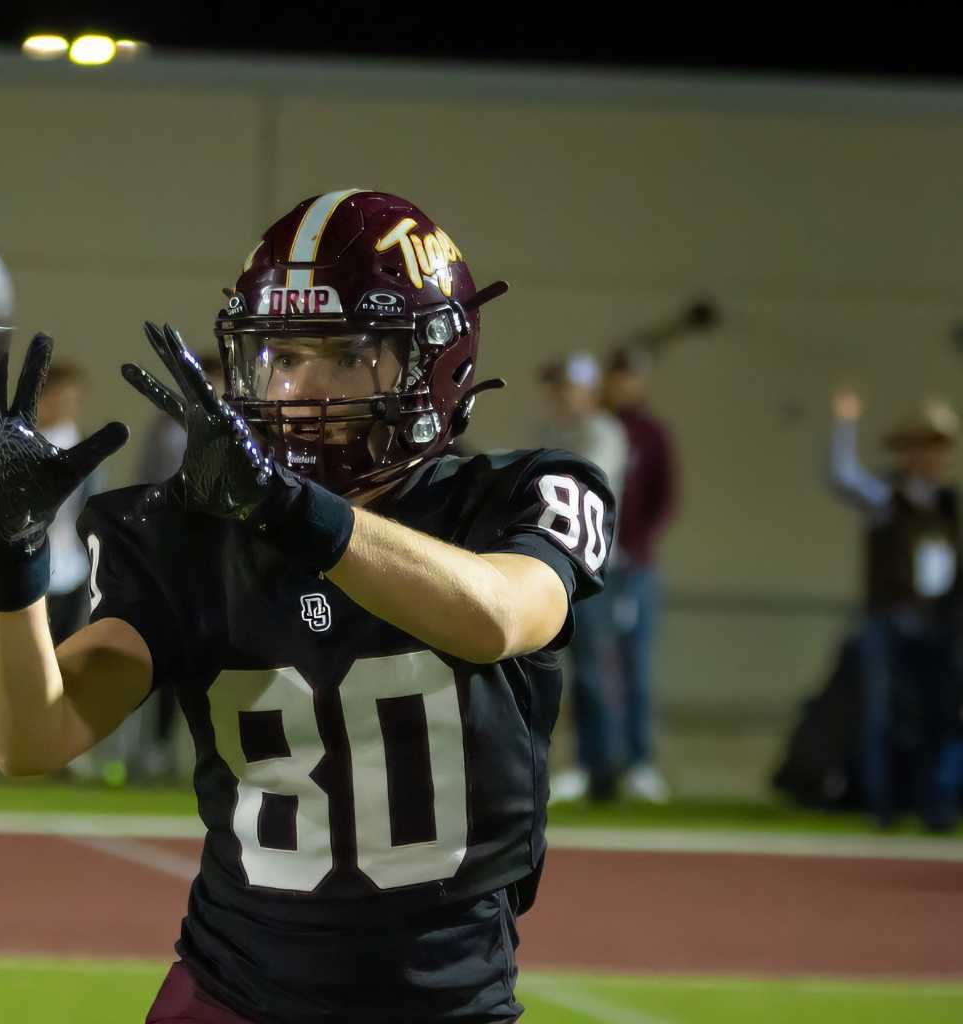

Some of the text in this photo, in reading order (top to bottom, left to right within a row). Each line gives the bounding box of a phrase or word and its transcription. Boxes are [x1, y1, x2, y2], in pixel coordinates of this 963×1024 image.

[268, 289, 329, 317] DRIP
[538, 474, 607, 573] 80
[207, 649, 469, 892] 80
